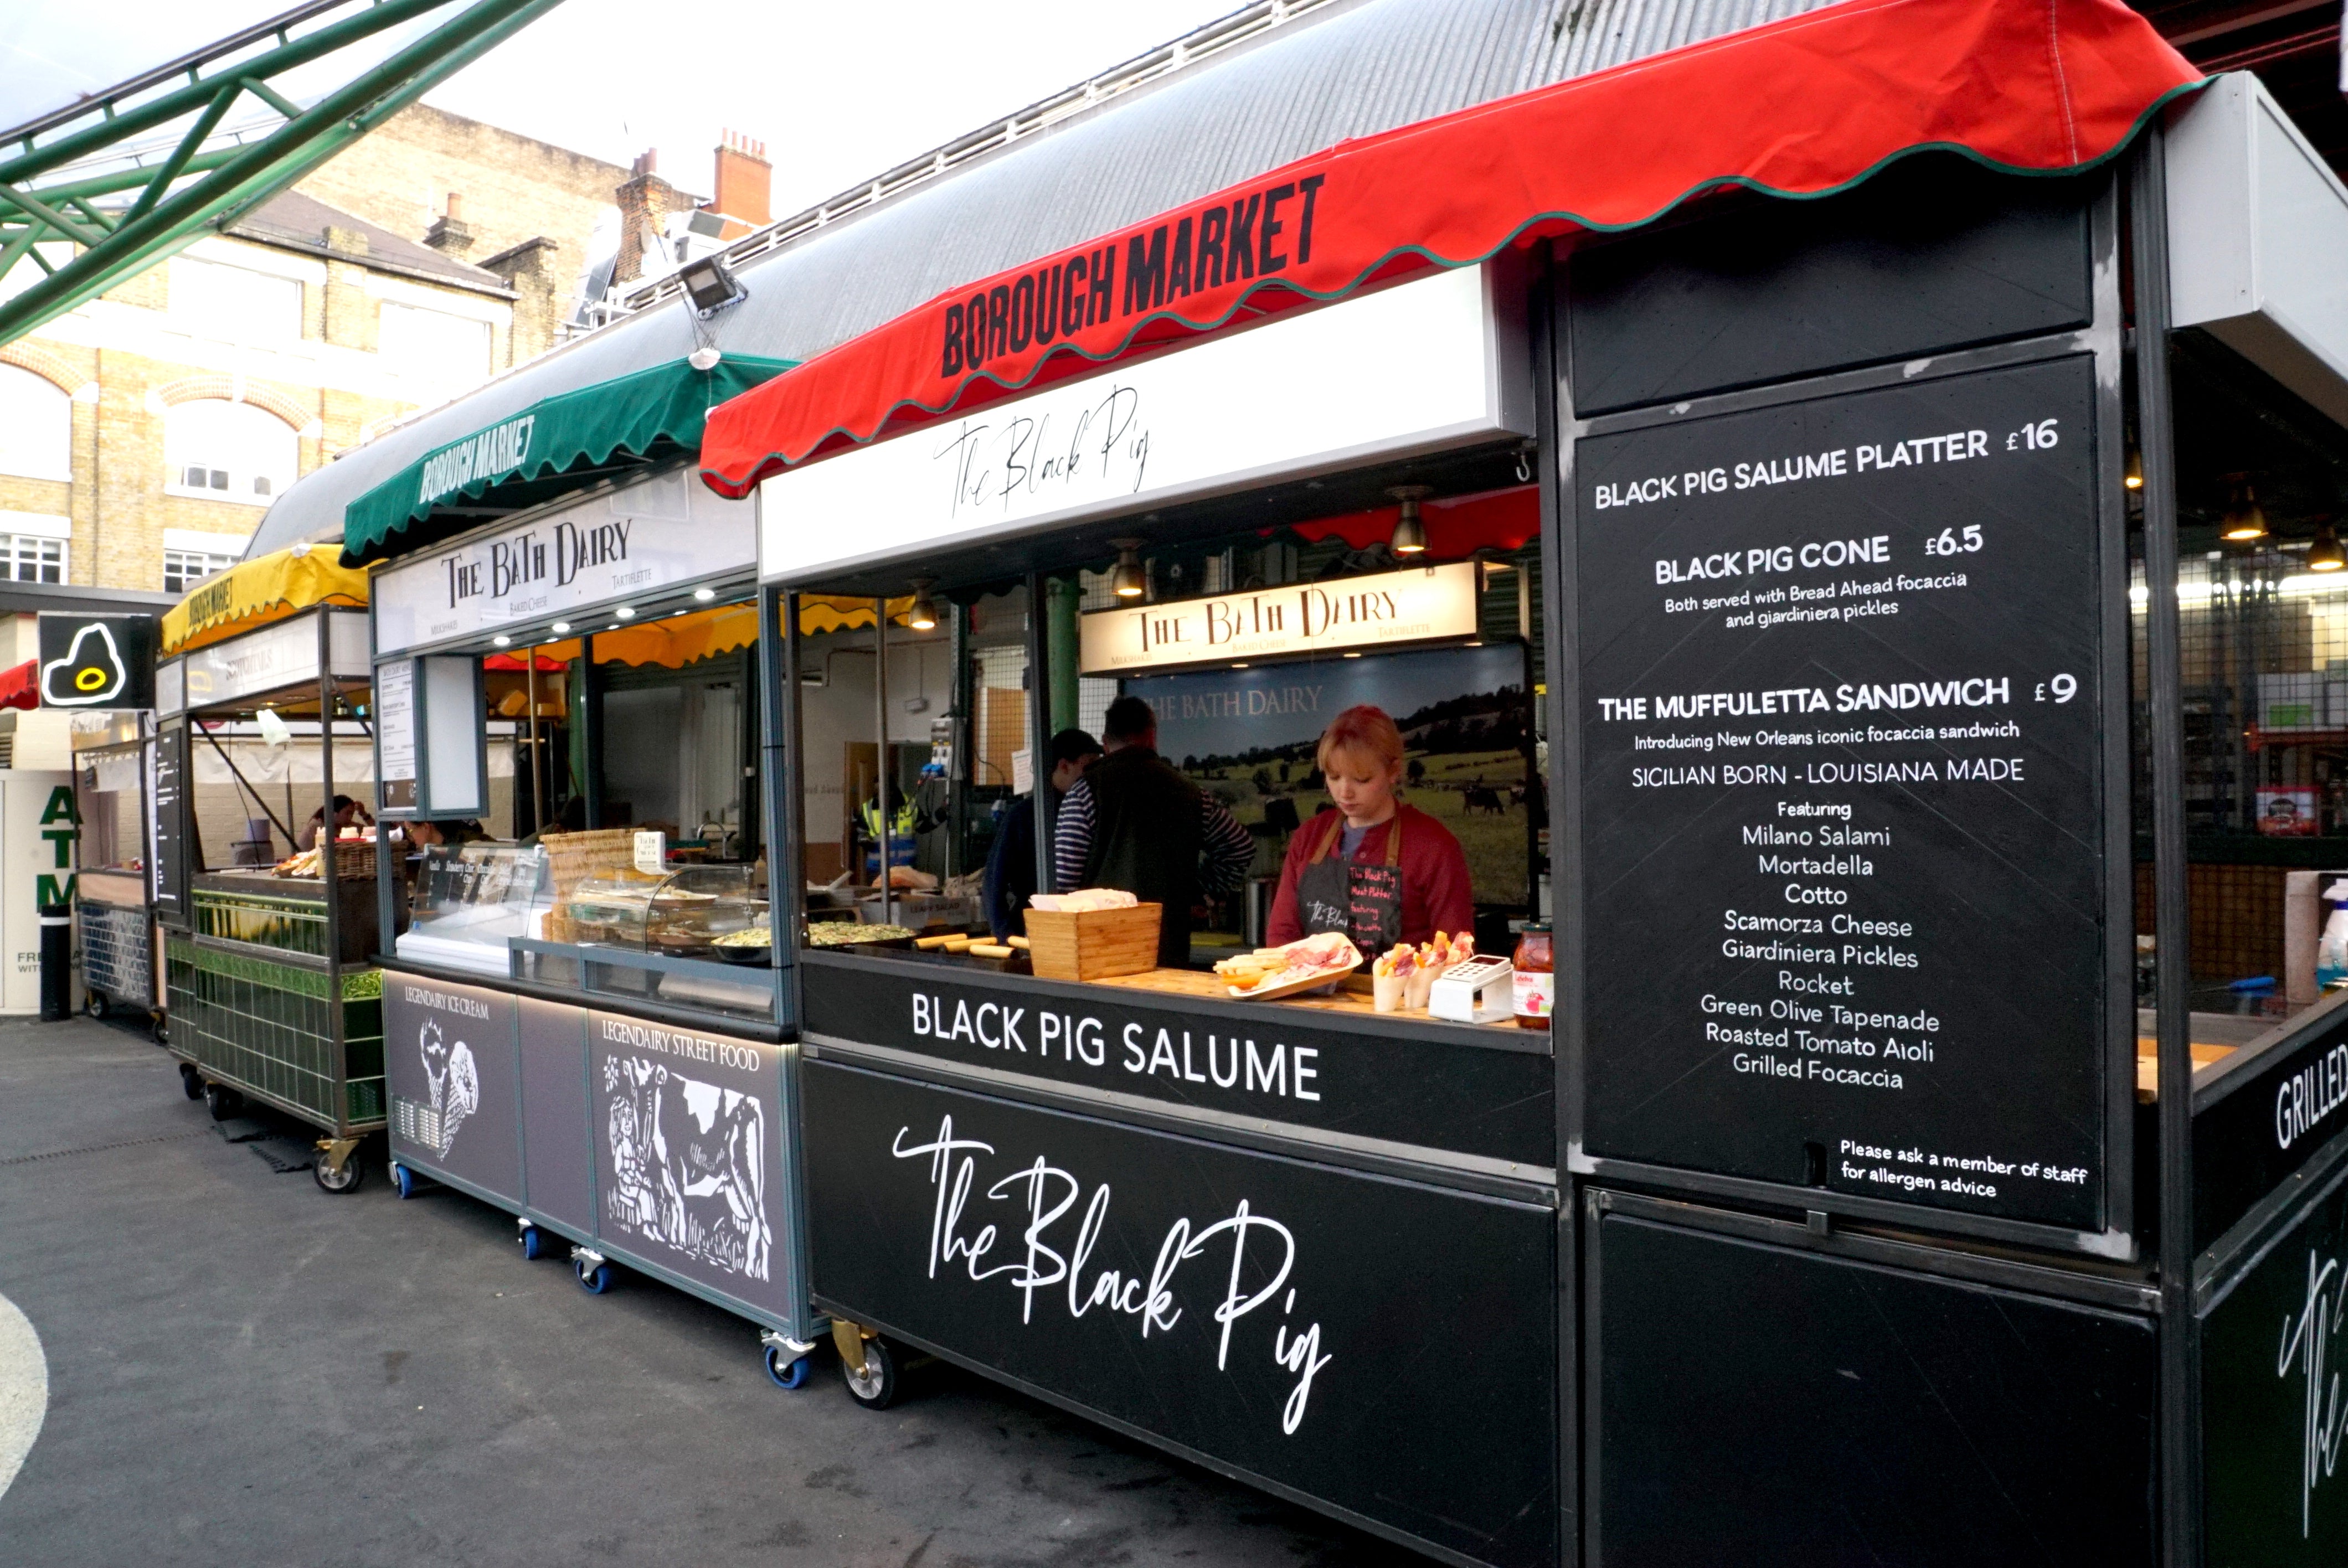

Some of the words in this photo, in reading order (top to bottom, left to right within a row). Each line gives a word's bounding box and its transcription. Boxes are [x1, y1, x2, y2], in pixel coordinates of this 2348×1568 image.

[941, 245, 1115, 379] BOROUGH
[1123, 173, 1326, 316] MARKET
[419, 437, 477, 504] BOROUGH
[473, 415, 535, 480] MARKET
[934, 420, 990, 520] The
[989, 410, 1090, 513] Black
[1085, 384, 1154, 492] Pig
[1595, 475, 1678, 509] BLACK
[1684, 467, 1728, 496] PIG
[1734, 448, 1847, 489] SALUME
[1856, 430, 1989, 472] PLATTER
[441, 553, 484, 609] THE
[491, 530, 545, 599] BATH
[554, 519, 632, 587] DAIRY
[1655, 551, 1742, 585] BLACK
[1747, 546, 1793, 575] PIG
[1799, 535, 1891, 568] CONE
[1925, 524, 1983, 556] £6.5
[1665, 596, 1698, 613] Both
[1702, 590, 1750, 610] served
[1754, 587, 1785, 604] with
[1790, 582, 1835, 601] Bread
[1840, 577, 1893, 597] Ahead
[1896, 572, 1967, 591] focaccia
[1129, 610, 1191, 652] THE
[1204, 594, 1284, 646] BATH
[1296, 589, 1403, 637] DAIRY
[1726, 611, 1754, 628] and
[1758, 606, 1840, 629] giardiniera
[1844, 599, 1899, 622] pickles
[1232, 642, 1258, 653] BAKED
[1259, 639, 1286, 651] CHEESE
[1143, 695, 1175, 722] HE
[1182, 691, 1240, 719] BATH
[1247, 685, 1323, 716] DAIRY
[1598, 697, 1647, 721] THE
[1655, 688, 1831, 719] MUFFULETTA
[1836, 677, 2009, 713] SANDWICH
[1635, 733, 1713, 752] Introducing
[1717, 731, 1752, 747] New
[1755, 730, 1814, 745] Orleans
[1817, 728, 1864, 744] iconic
[1867, 725, 1934, 742] focaccia
[1939, 720, 2020, 739] sandwich
[1632, 766, 1715, 787] SICILIAN
[1723, 764, 1786, 785] BORN
[1808, 761, 1938, 783] LOUISIANA
[1948, 758, 2025, 781] MADE
[1778, 801, 1851, 821] Featuring
[1743, 824, 1813, 846] Milano
[1820, 824, 1890, 846] Salami
[1364, 867, 1382, 881] Black
[1383, 870, 1396, 889] Pig
[1759, 854, 1873, 876] Mortadella
[1307, 901, 1325, 923] The
[1785, 883, 1847, 905] Cotto
[1724, 909, 1823, 933] Scamorza
[1831, 914, 1912, 937] Cheese
[1722, 938, 1836, 964] Giardiniera
[1844, 945, 1918, 968] Pickles
[1779, 970, 1855, 996] Rocket
[405, 986, 446, 1010] LEGENDAIRY
[448, 996, 459, 1013] ICE
[460, 998, 489, 1020] CREAM
[1701, 994, 1762, 1017] Green
[1770, 999, 1822, 1022] Olive
[1829, 1005, 1939, 1031] Tapenade
[603, 1020, 670, 1053] LEGENDAIRY
[673, 1034, 717, 1063] STREET
[719, 1044, 760, 1072] FOOD
[913, 993, 1027, 1052] BLACK
[1041, 1011, 1105, 1065] PIG
[1123, 1023, 1320, 1101] SALUME
[1706, 1022, 1788, 1048] Roasted
[1794, 1030, 1876, 1056] Tomato
[1883, 1037, 1933, 1062] Aioli
[1733, 1053, 1801, 1079] Grilled
[1808, 1060, 1903, 1089] Focaccia
[2277, 1043, 2348, 1149] GRILLED
[1841, 1139, 1892, 1159] Please
[1897, 1147, 1924, 1163] ask
[1929, 1154, 1939, 1165] a
[1943, 1156, 2016, 1175] member
[2021, 1162, 2040, 1177] of
[2043, 1165, 2088, 1184] staff
[1841, 1160, 1866, 1179] for
[1869, 1167, 1935, 1191] allergen
[1940, 1177, 1996, 1197] advice
[893, 1115, 1003, 1281] The
[988, 1155, 1190, 1338] Black
[1182, 1199, 1332, 1435] Pig
